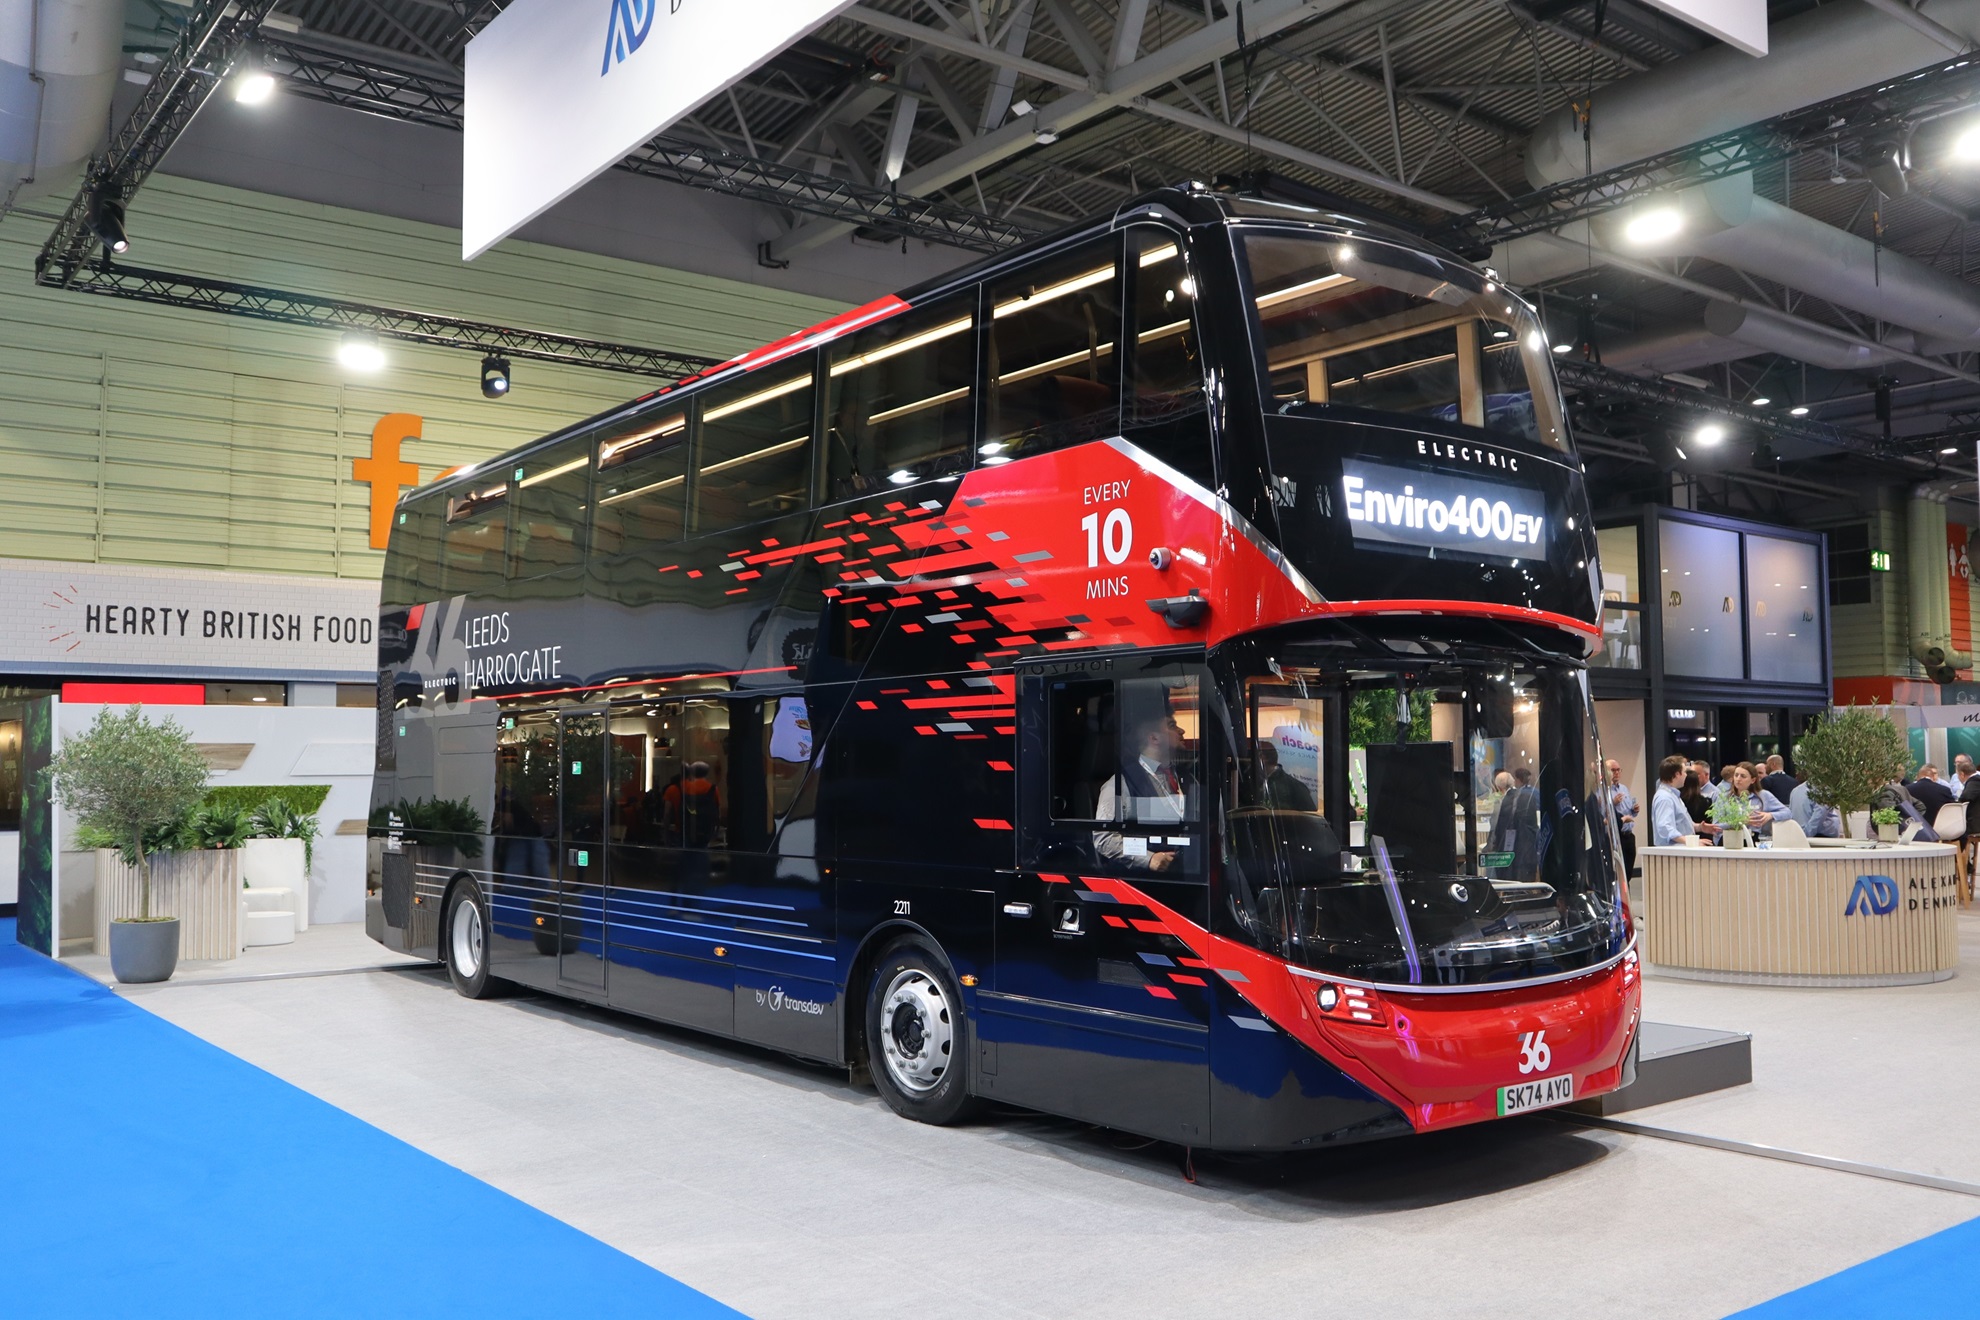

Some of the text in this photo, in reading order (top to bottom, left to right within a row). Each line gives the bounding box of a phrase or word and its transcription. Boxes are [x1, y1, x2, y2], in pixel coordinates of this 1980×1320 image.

[1417, 440, 1519, 472] ELECTRIC
[1084, 479, 1131, 505] EVERY
[1342, 474, 1544, 545] Enviro400EV
[1081, 507, 1133, 568] 10
[1086, 575, 1129, 600] MINS
[86, 603, 190, 639] HEARTY
[203, 609, 302, 643] BRITISH
[314, 615, 373, 645] FOOD
[465, 611, 510, 650] LEEDS
[464, 645, 562, 690] HARROGATE
[424, 676, 457, 689] ELECTRIC
[893, 899, 911, 915] 2211
[1909, 895, 1956, 910] DENNIS
[755, 989, 825, 1016] by transdev
[1518, 1029, 1551, 1075] 36
[1507, 1083, 1543, 1110] SK74
